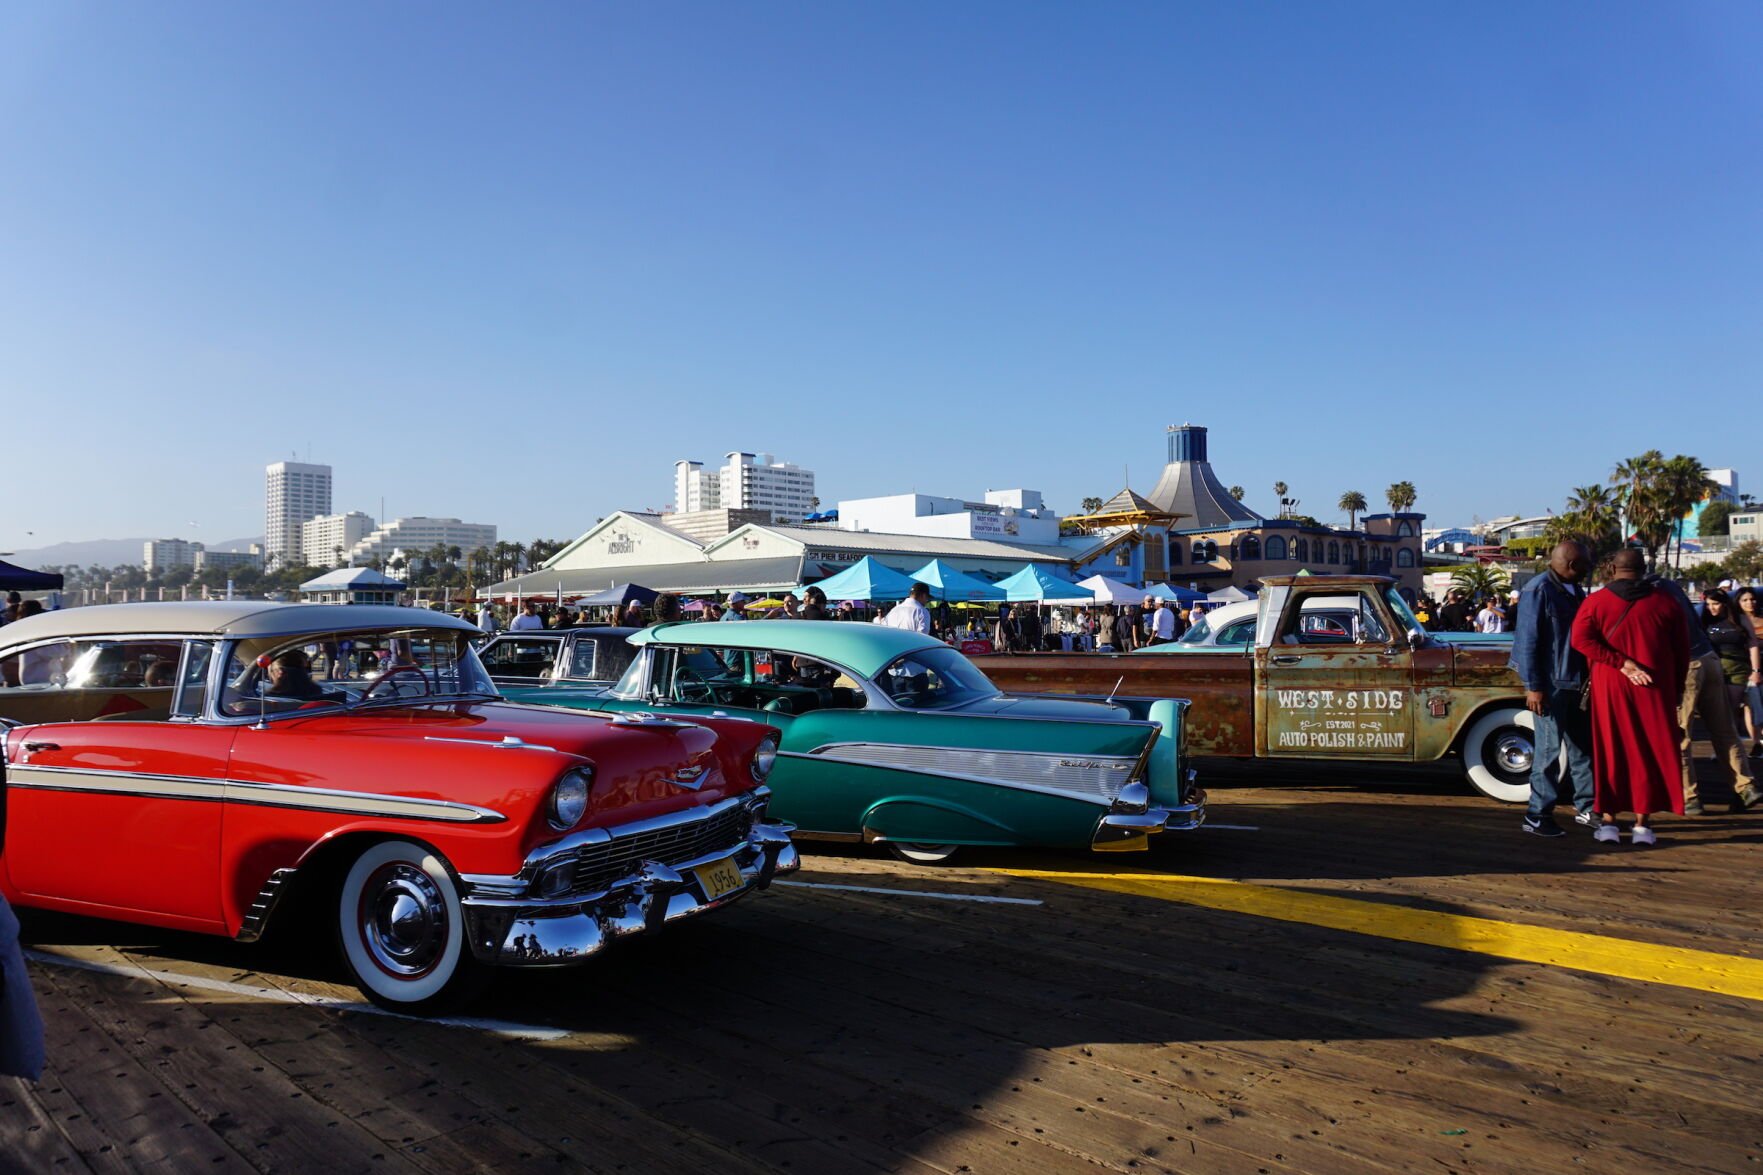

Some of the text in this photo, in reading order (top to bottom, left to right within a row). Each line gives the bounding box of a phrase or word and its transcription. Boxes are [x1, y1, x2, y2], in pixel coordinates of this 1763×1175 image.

[821, 552, 836, 561] PIER
[1278, 690, 1403, 709] WEST SIDE
[1279, 731, 1405, 748] AUTO POLISH & PAINT
[709, 868, 737, 893] 1956
